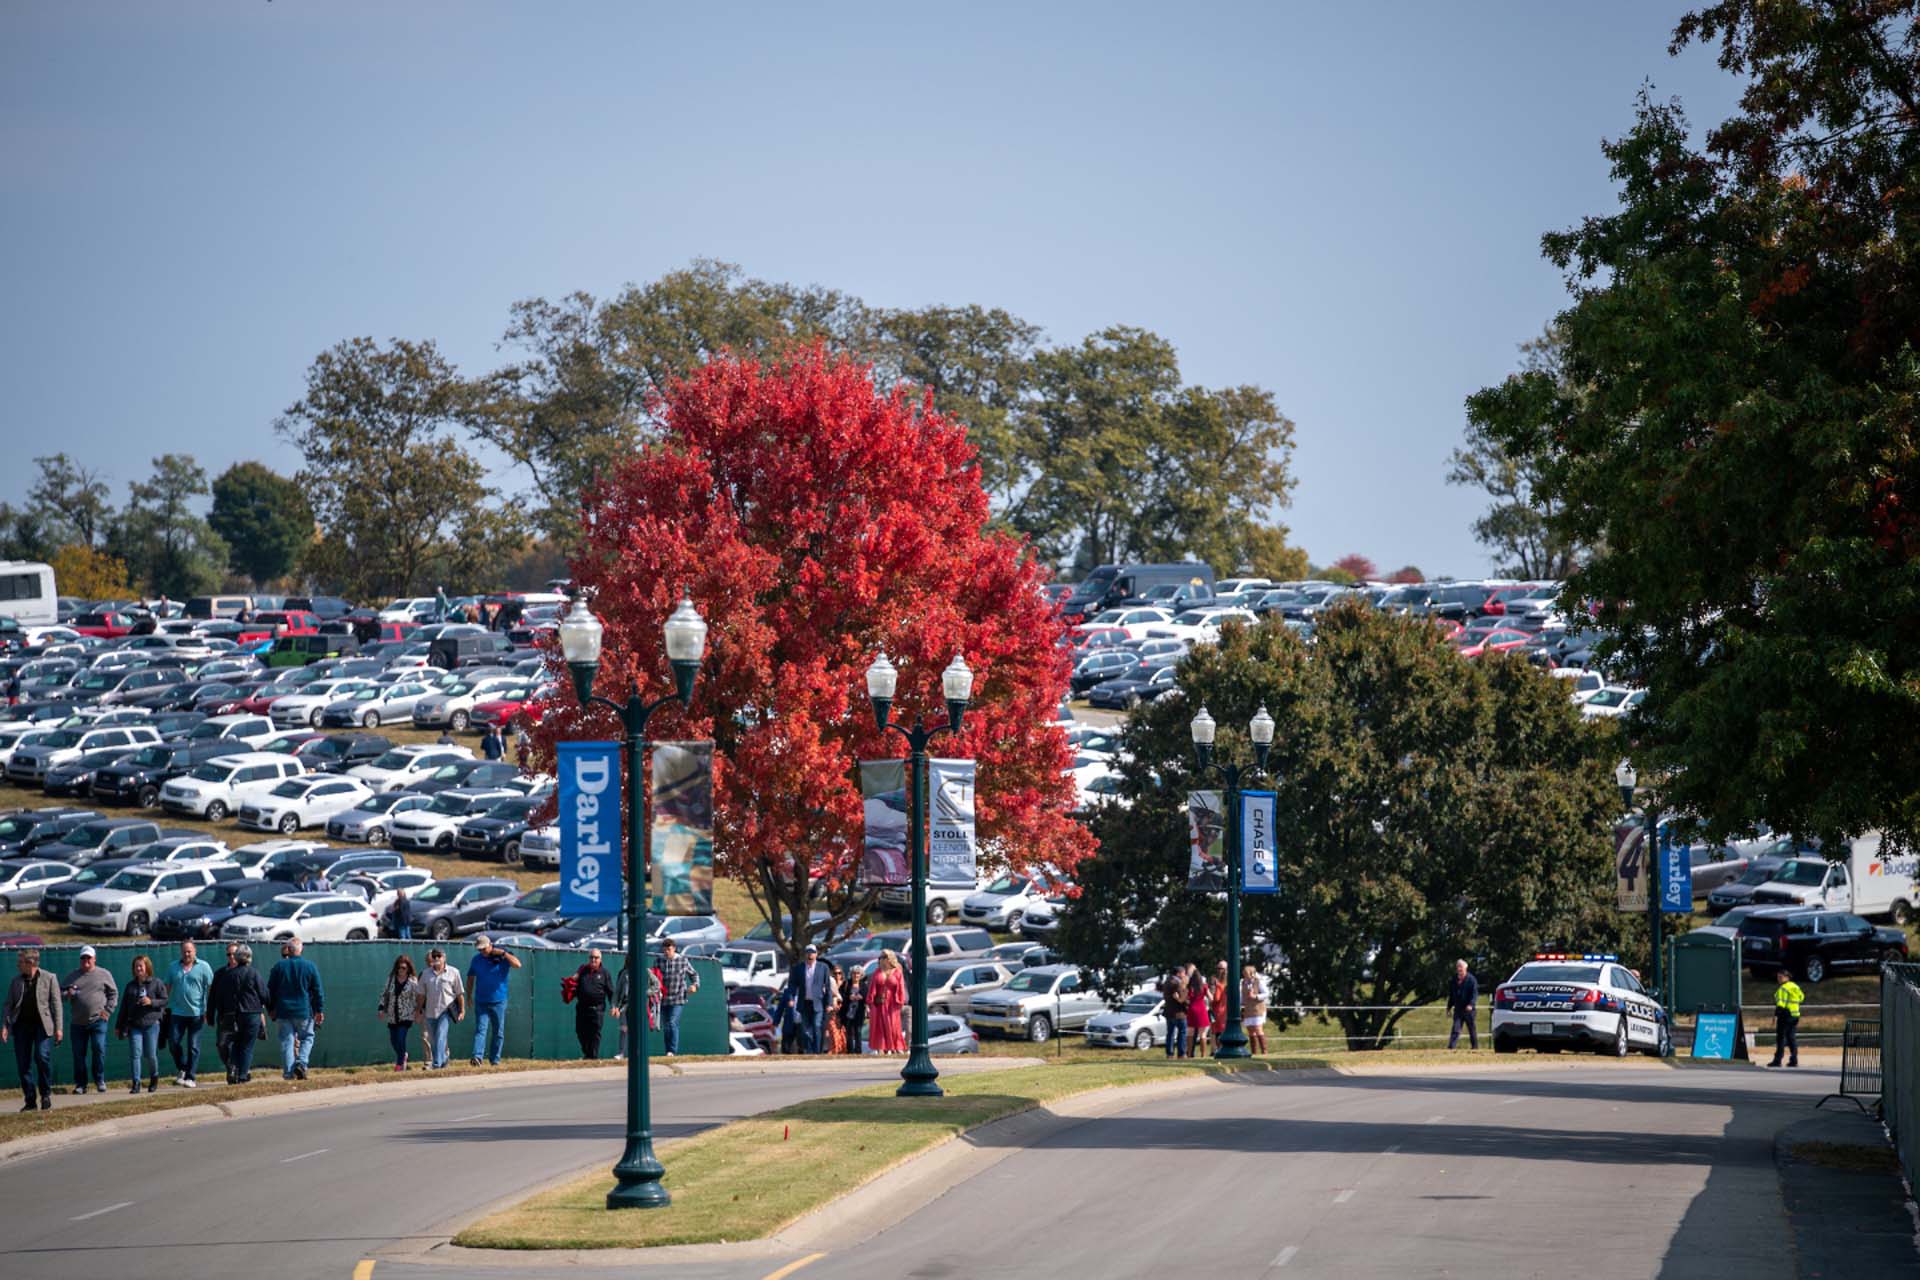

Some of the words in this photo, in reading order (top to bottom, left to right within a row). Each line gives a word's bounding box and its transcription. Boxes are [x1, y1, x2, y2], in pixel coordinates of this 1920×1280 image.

[570, 756, 611, 902] Darley
[933, 830, 968, 839] STOLL
[1253, 808, 1264, 860] CHASE
[1884, 862, 1920, 877] Budge
[1515, 985, 1575, 993] LEXINGTON
[1513, 1001, 1575, 1009] POLICE
[1626, 1001, 1654, 1020] POLICE
